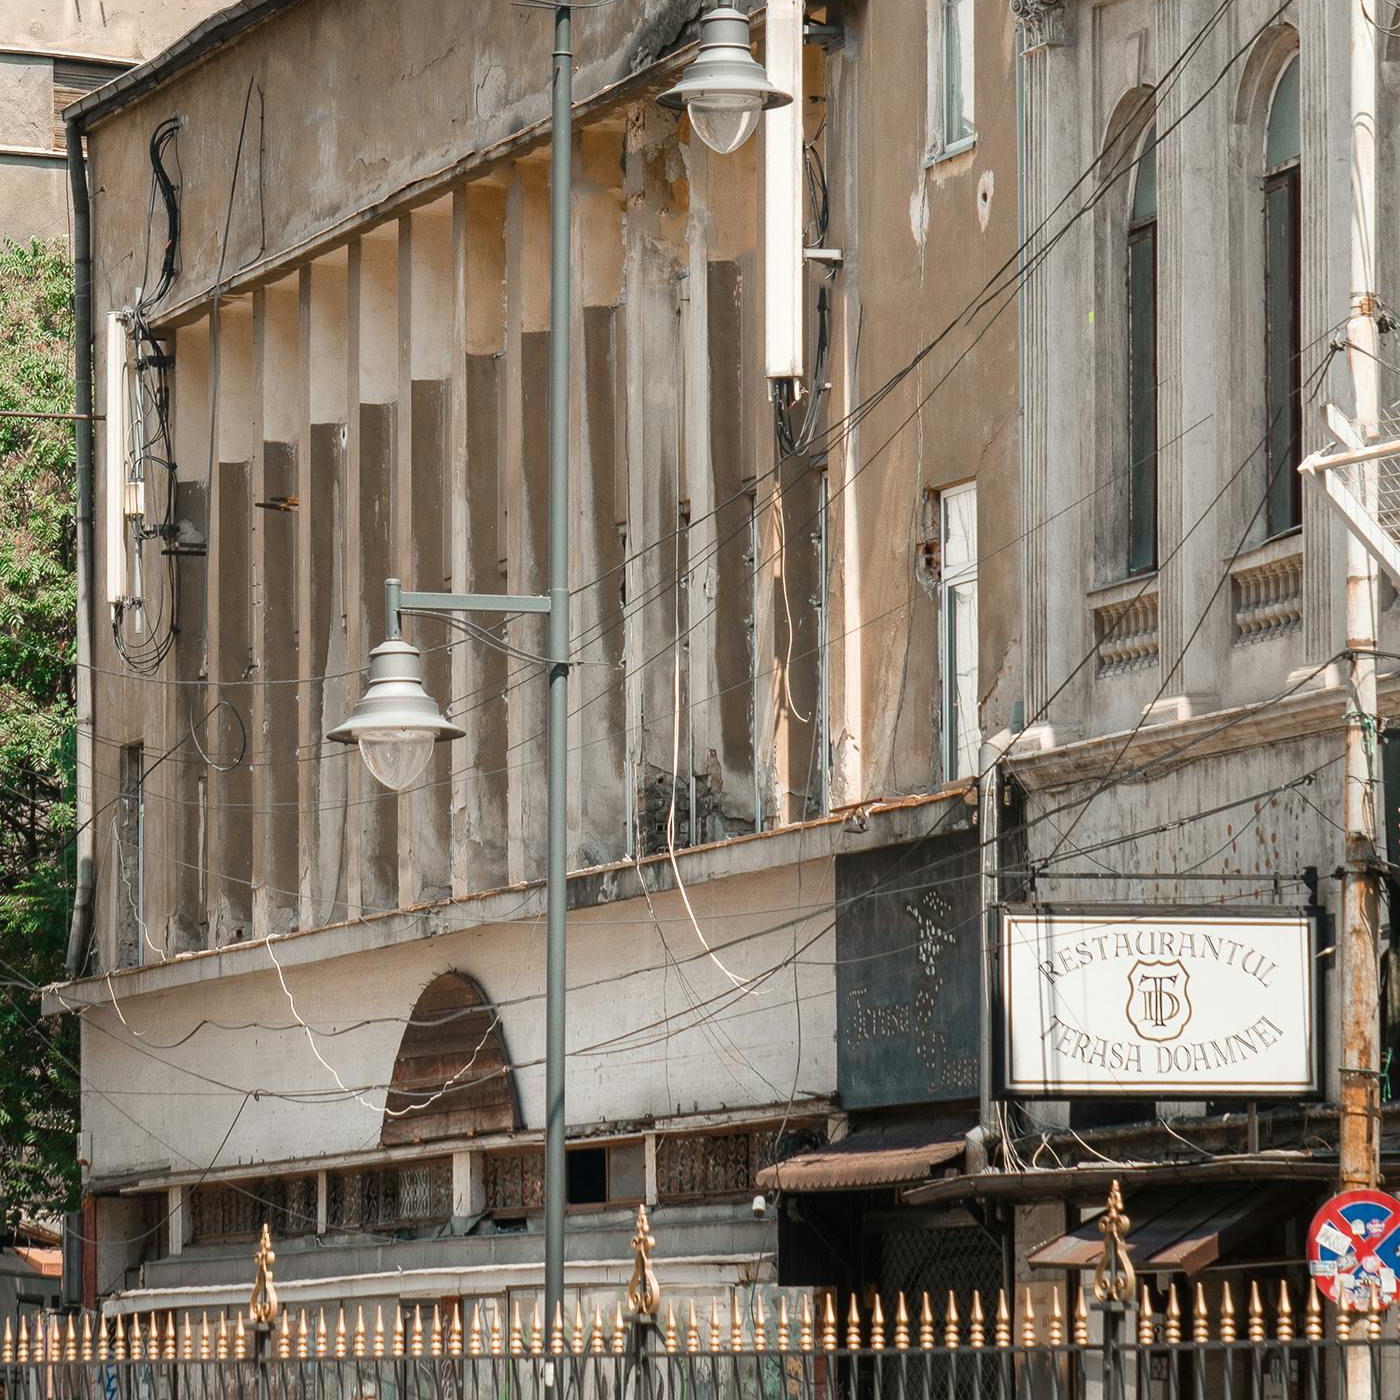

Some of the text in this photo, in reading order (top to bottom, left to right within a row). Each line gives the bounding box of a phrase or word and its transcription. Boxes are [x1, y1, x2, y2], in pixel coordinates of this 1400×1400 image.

[1037, 929, 1279, 988] RESTAURANTUL
[1040, 1014, 1284, 1074] TERASA DOAMNEI
